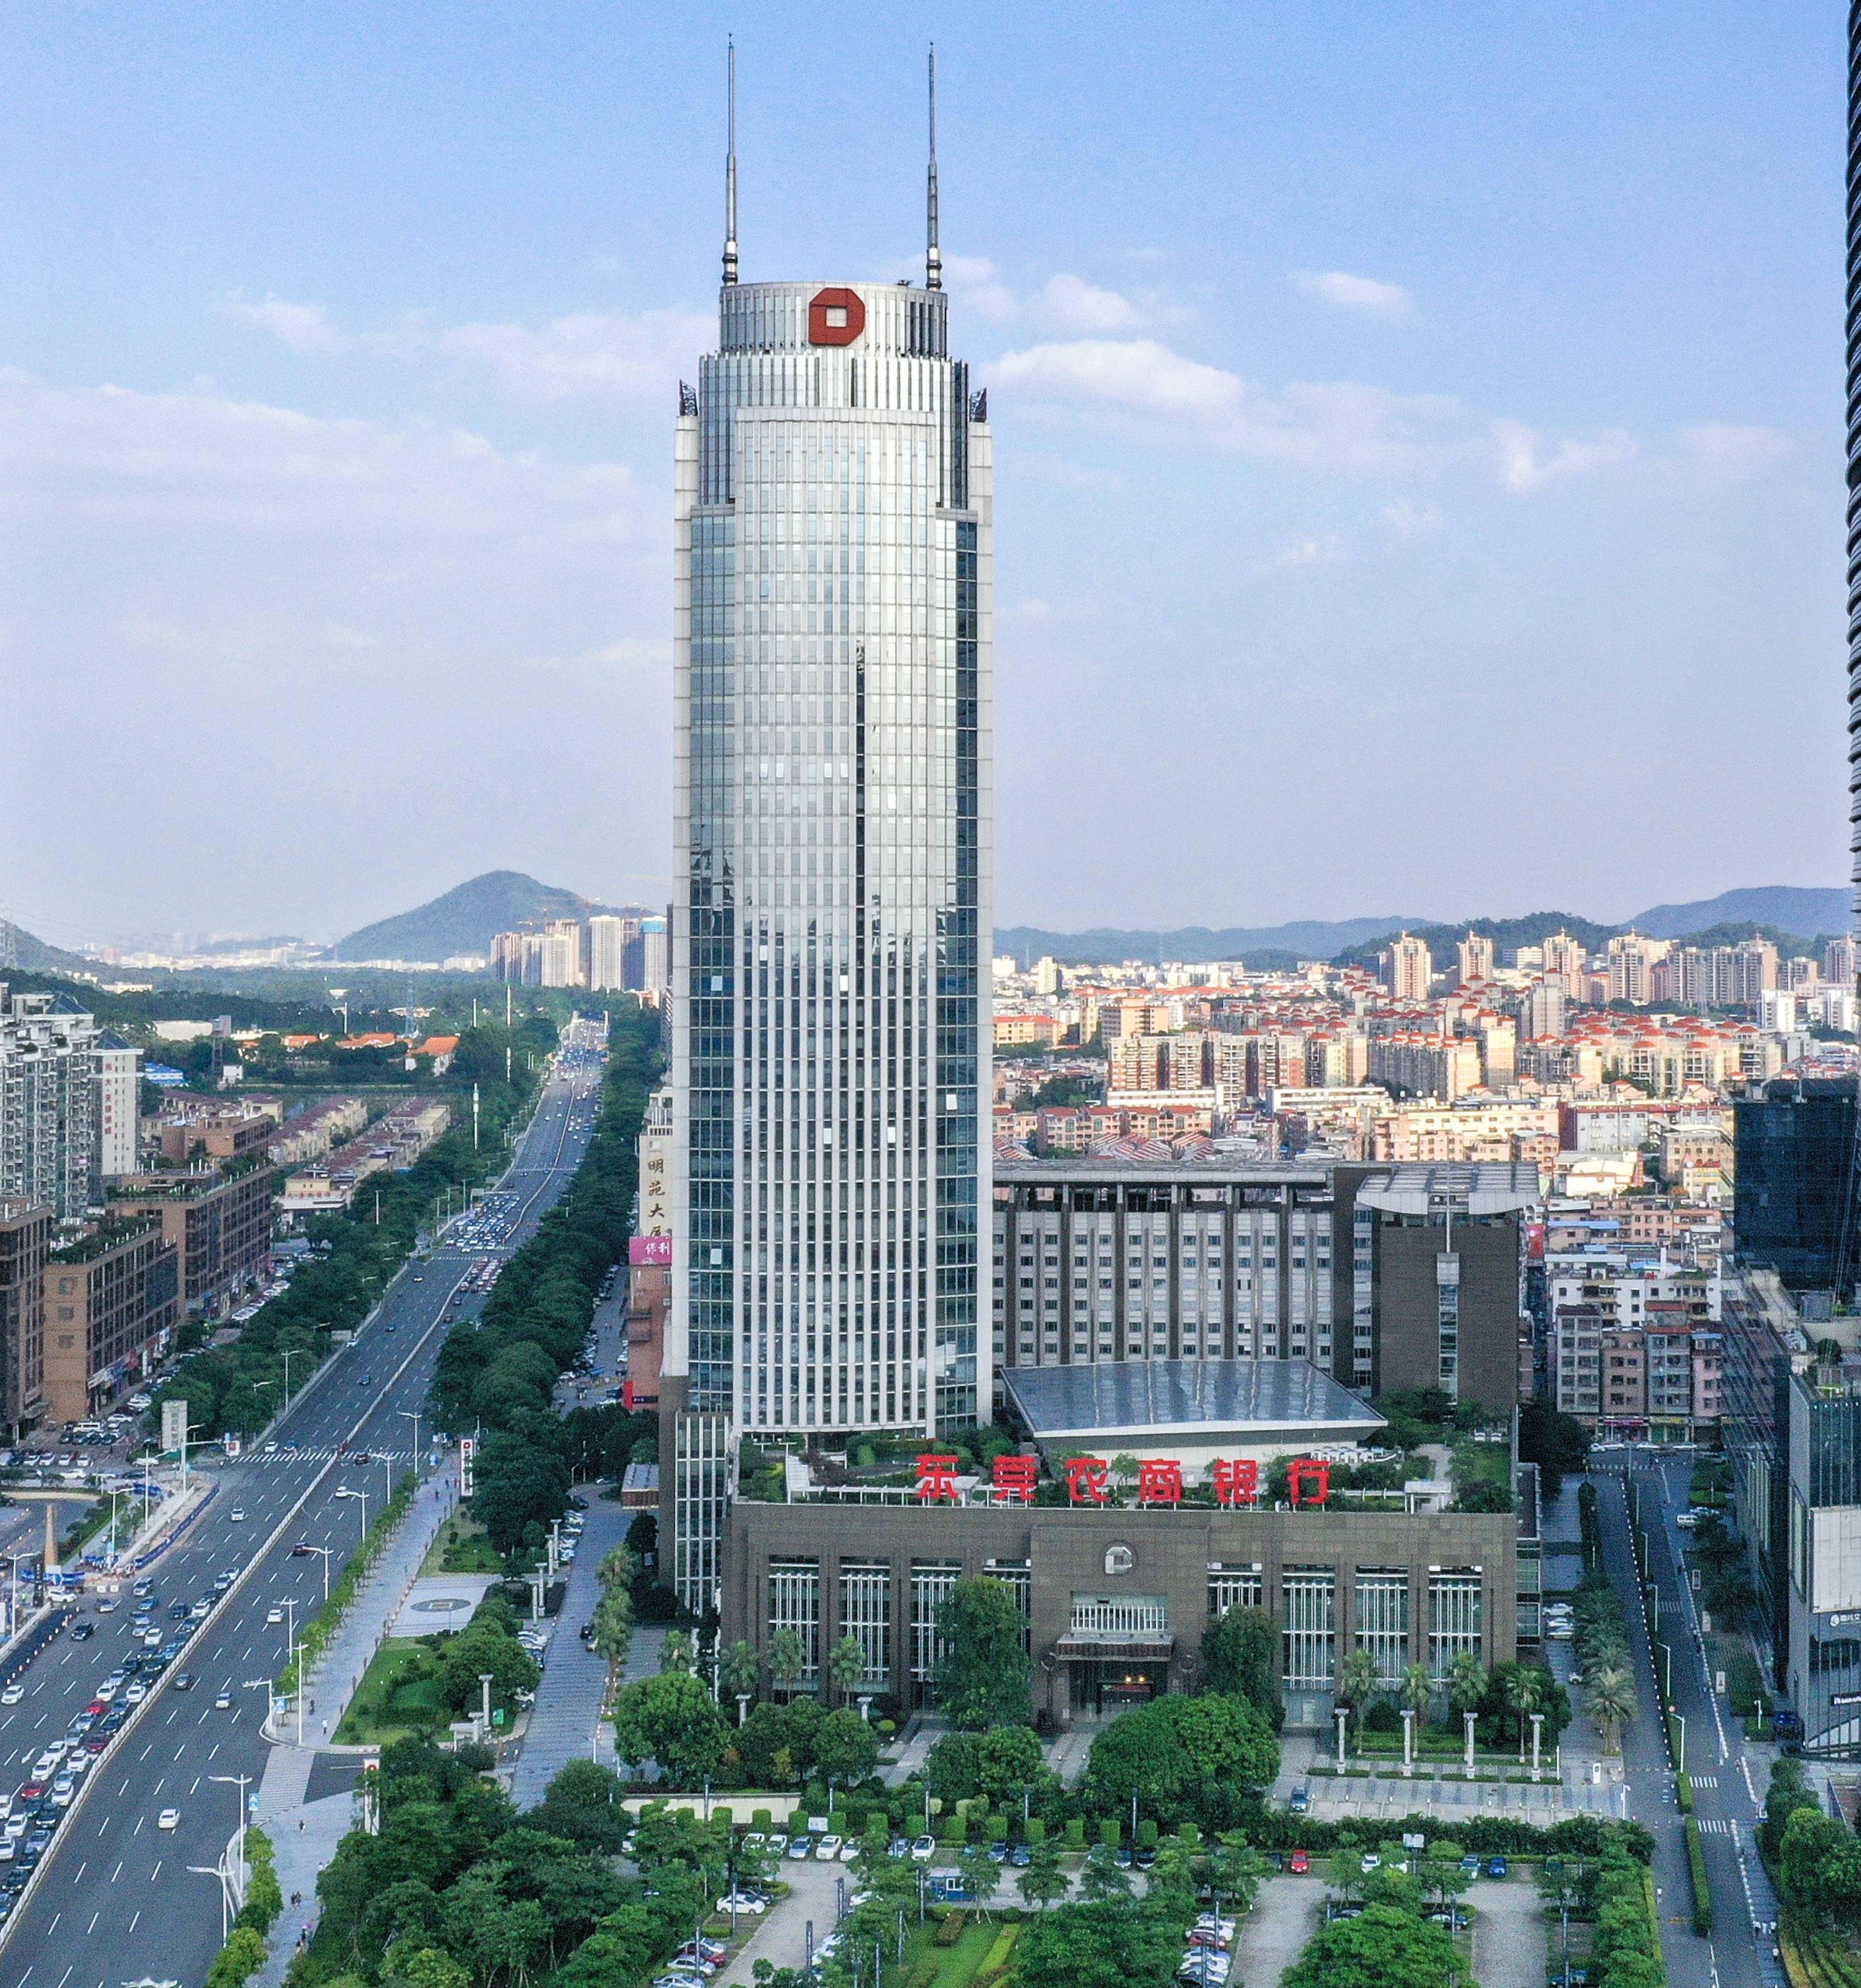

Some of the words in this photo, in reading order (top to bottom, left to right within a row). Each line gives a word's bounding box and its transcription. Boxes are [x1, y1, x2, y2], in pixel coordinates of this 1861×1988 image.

[917, 1454, 1330, 1503] 东莞农商银行
